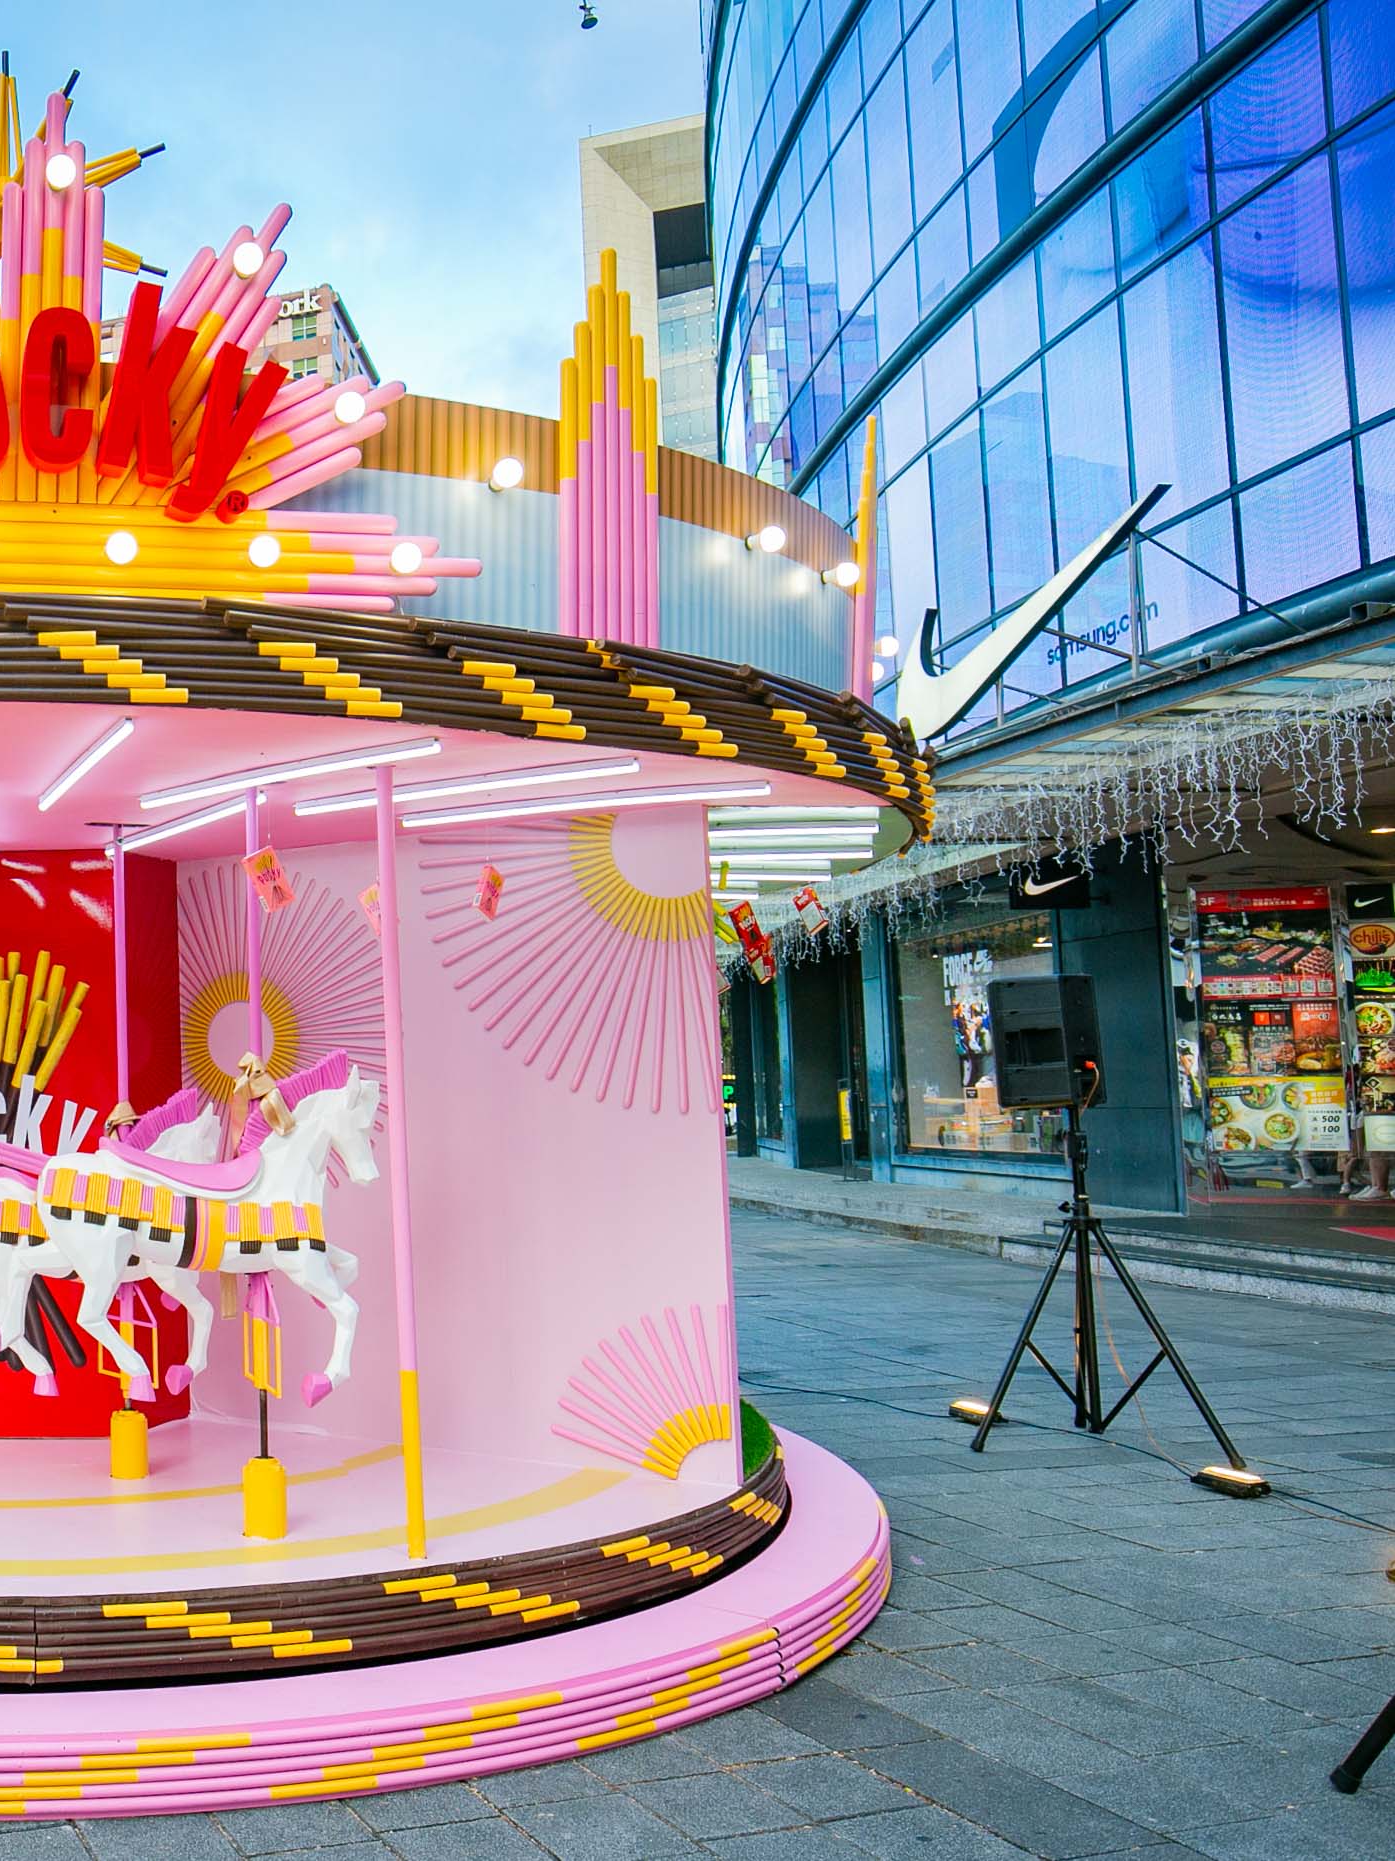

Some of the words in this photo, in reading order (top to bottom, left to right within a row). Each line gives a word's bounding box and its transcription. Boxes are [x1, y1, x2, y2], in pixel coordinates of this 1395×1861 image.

[278, 288, 323, 318] ork
[1046, 601, 1159, 666] samsung.cm
[1199, 896, 1216, 907] 3F
[943, 951, 974, 988] FORCE
[1321, 1115, 1341, 1124] 500
